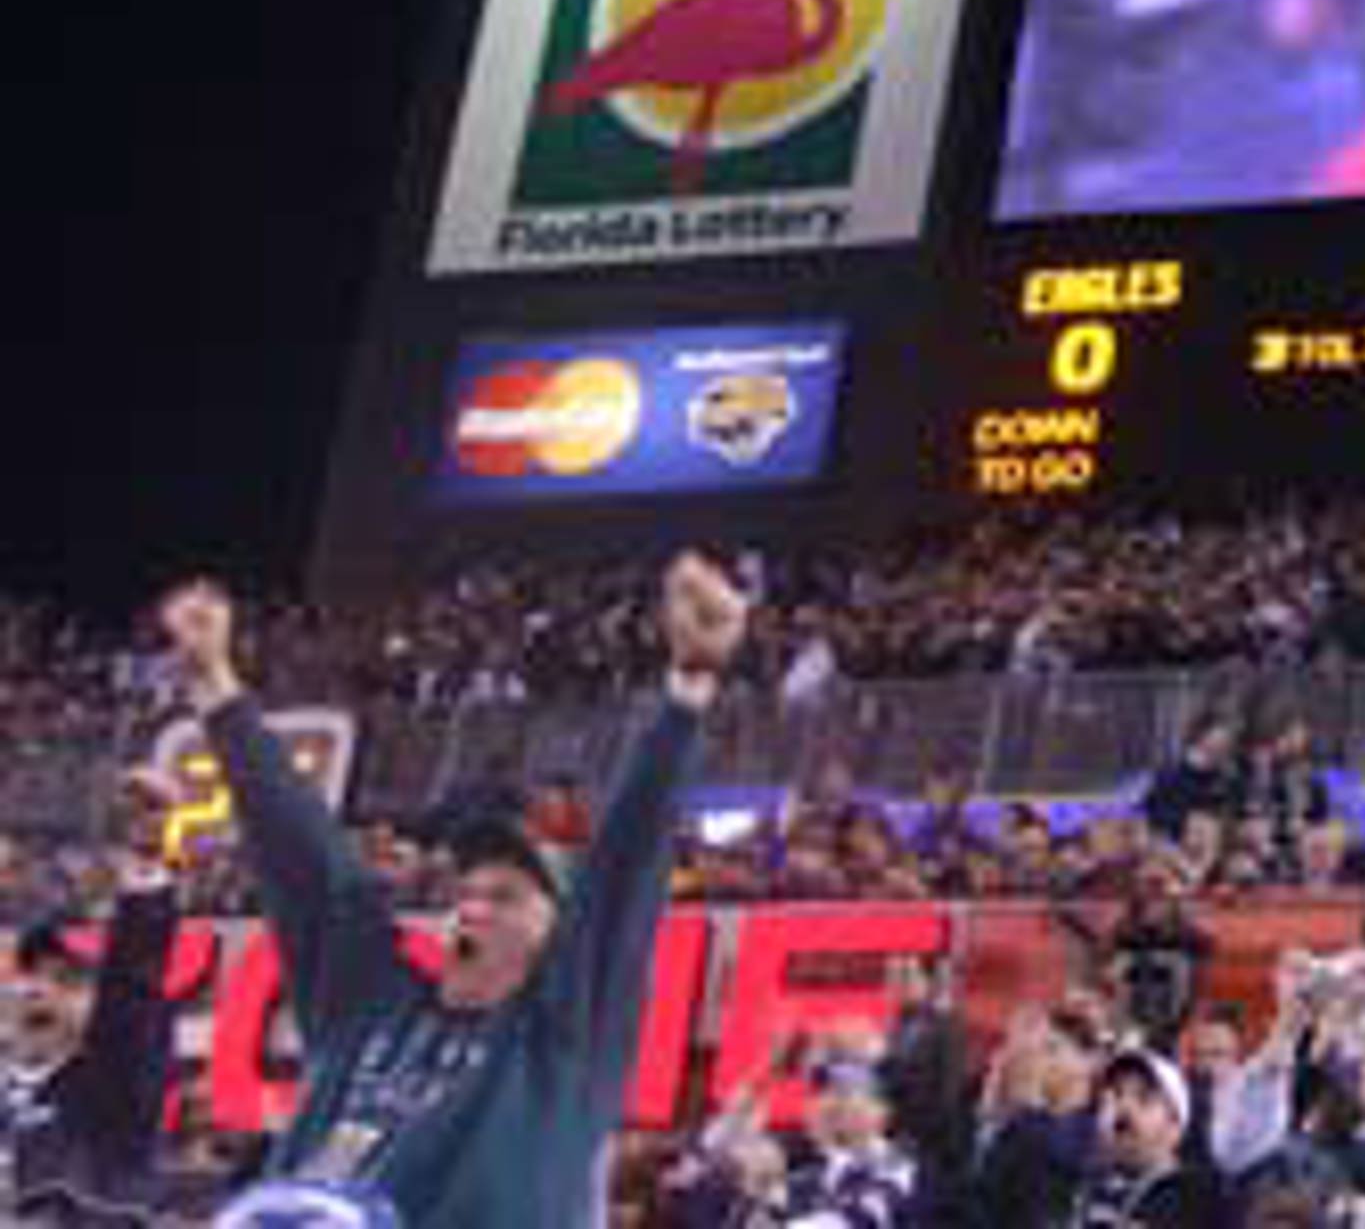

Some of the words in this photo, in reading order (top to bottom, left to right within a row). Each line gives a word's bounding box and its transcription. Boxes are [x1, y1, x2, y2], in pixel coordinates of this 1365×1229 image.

[496, 216, 657, 254] Florida
[670, 204, 851, 247] Lottery
[1022, 261, 1182, 317] EAGLES
[1048, 321, 1117, 395] 0
[973, 410, 1099, 451] DOWN
[977, 456, 1025, 493] TO
[1031, 450, 1094, 490] GO
